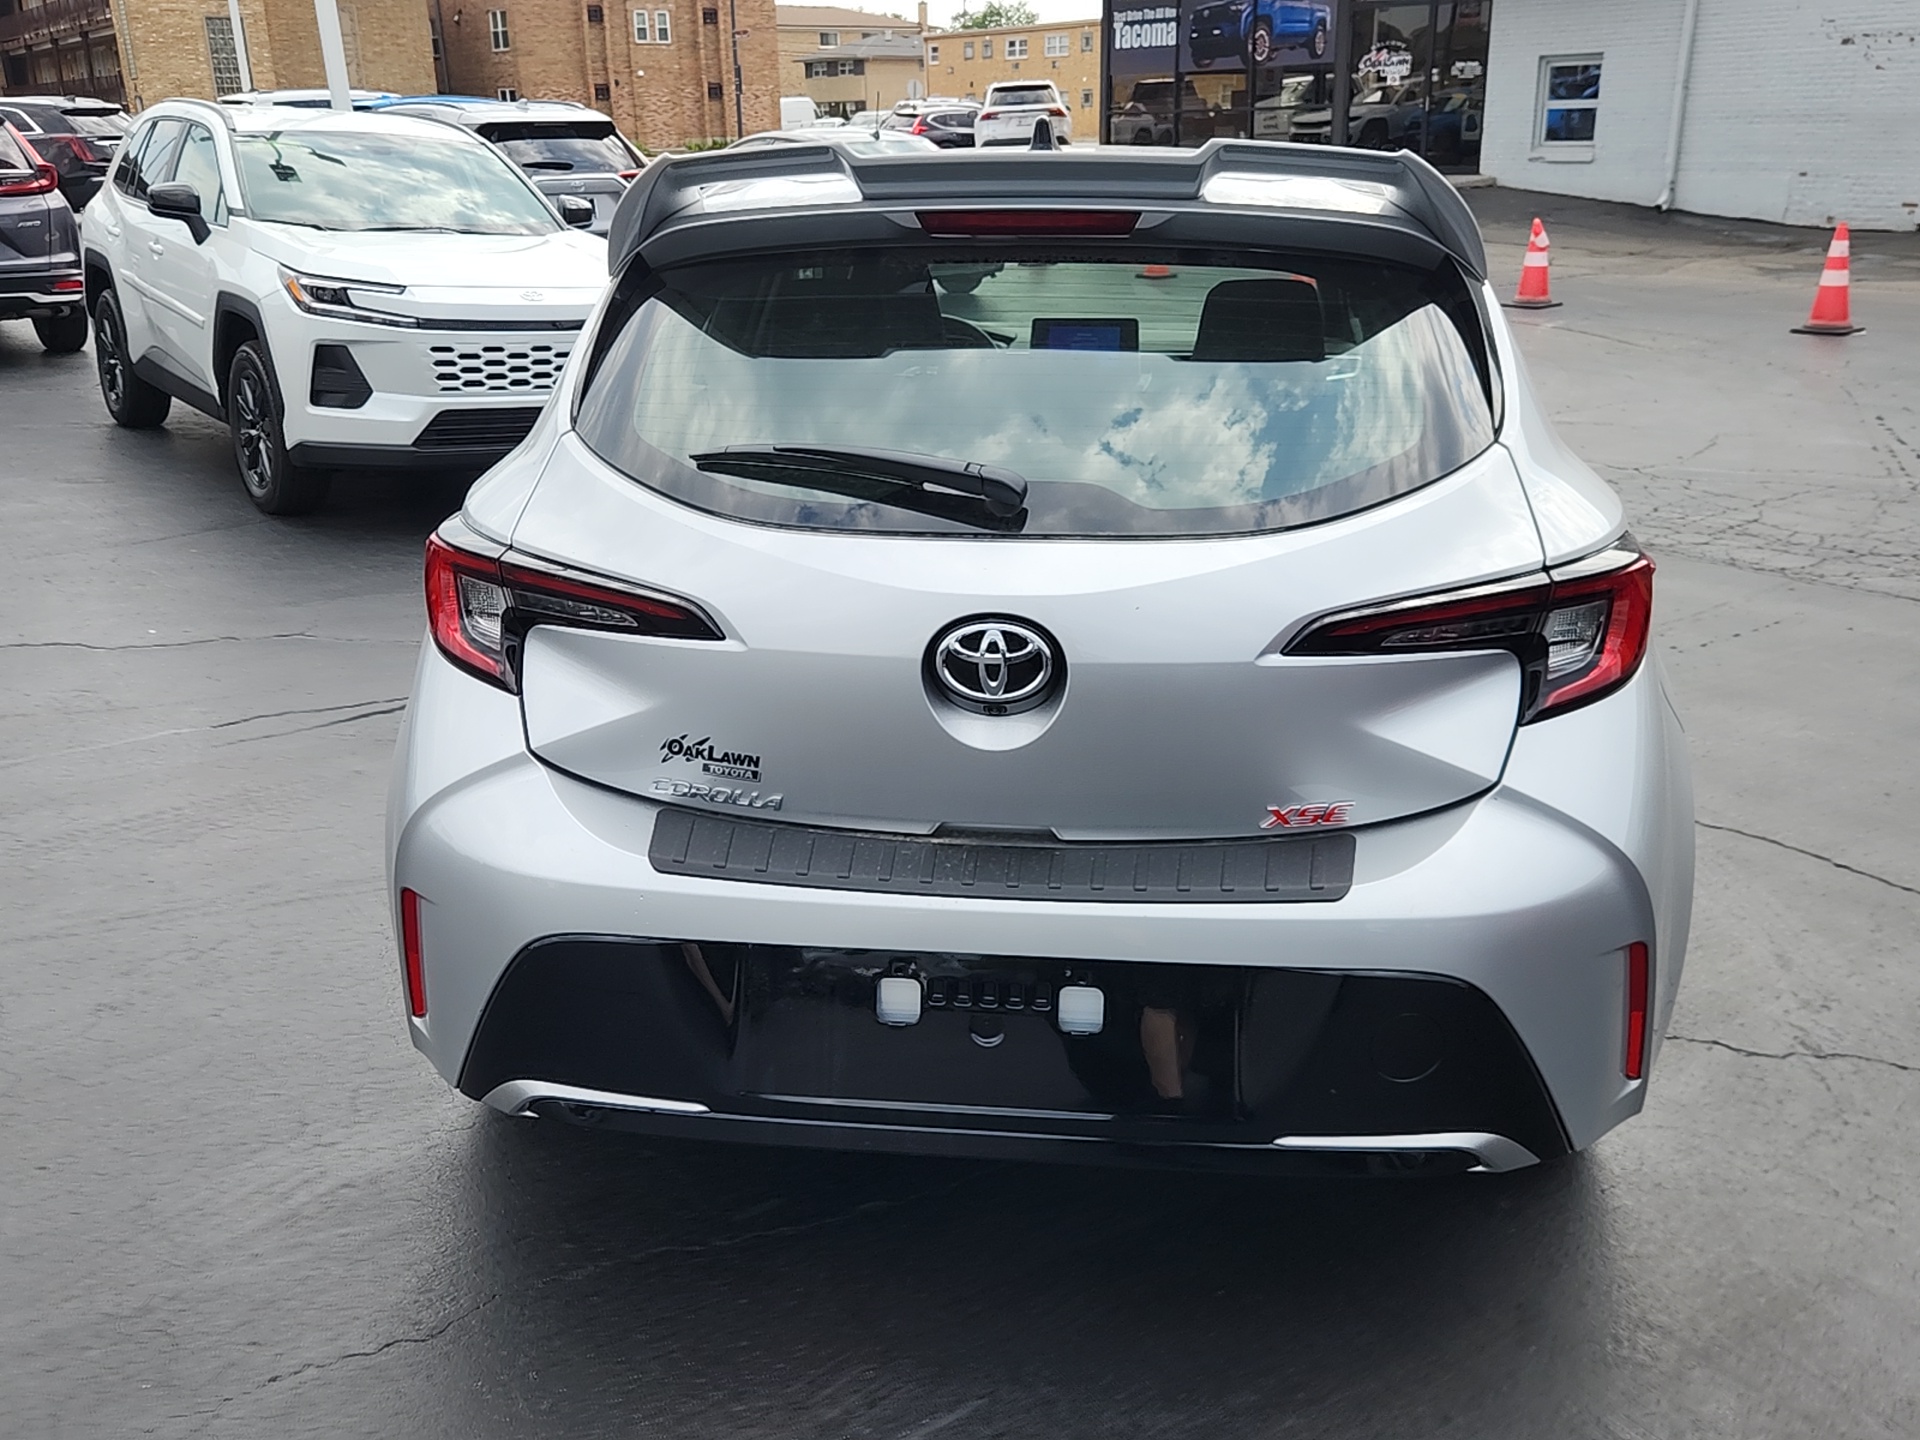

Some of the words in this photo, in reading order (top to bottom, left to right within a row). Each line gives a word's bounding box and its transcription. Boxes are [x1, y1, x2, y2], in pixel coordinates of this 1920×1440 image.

[1113, 22, 1177, 50] Tacoma
[708, 765, 754, 780] TOYOTA
[649, 777, 784, 811] COROLLA
[1259, 801, 1356, 829] XSE
